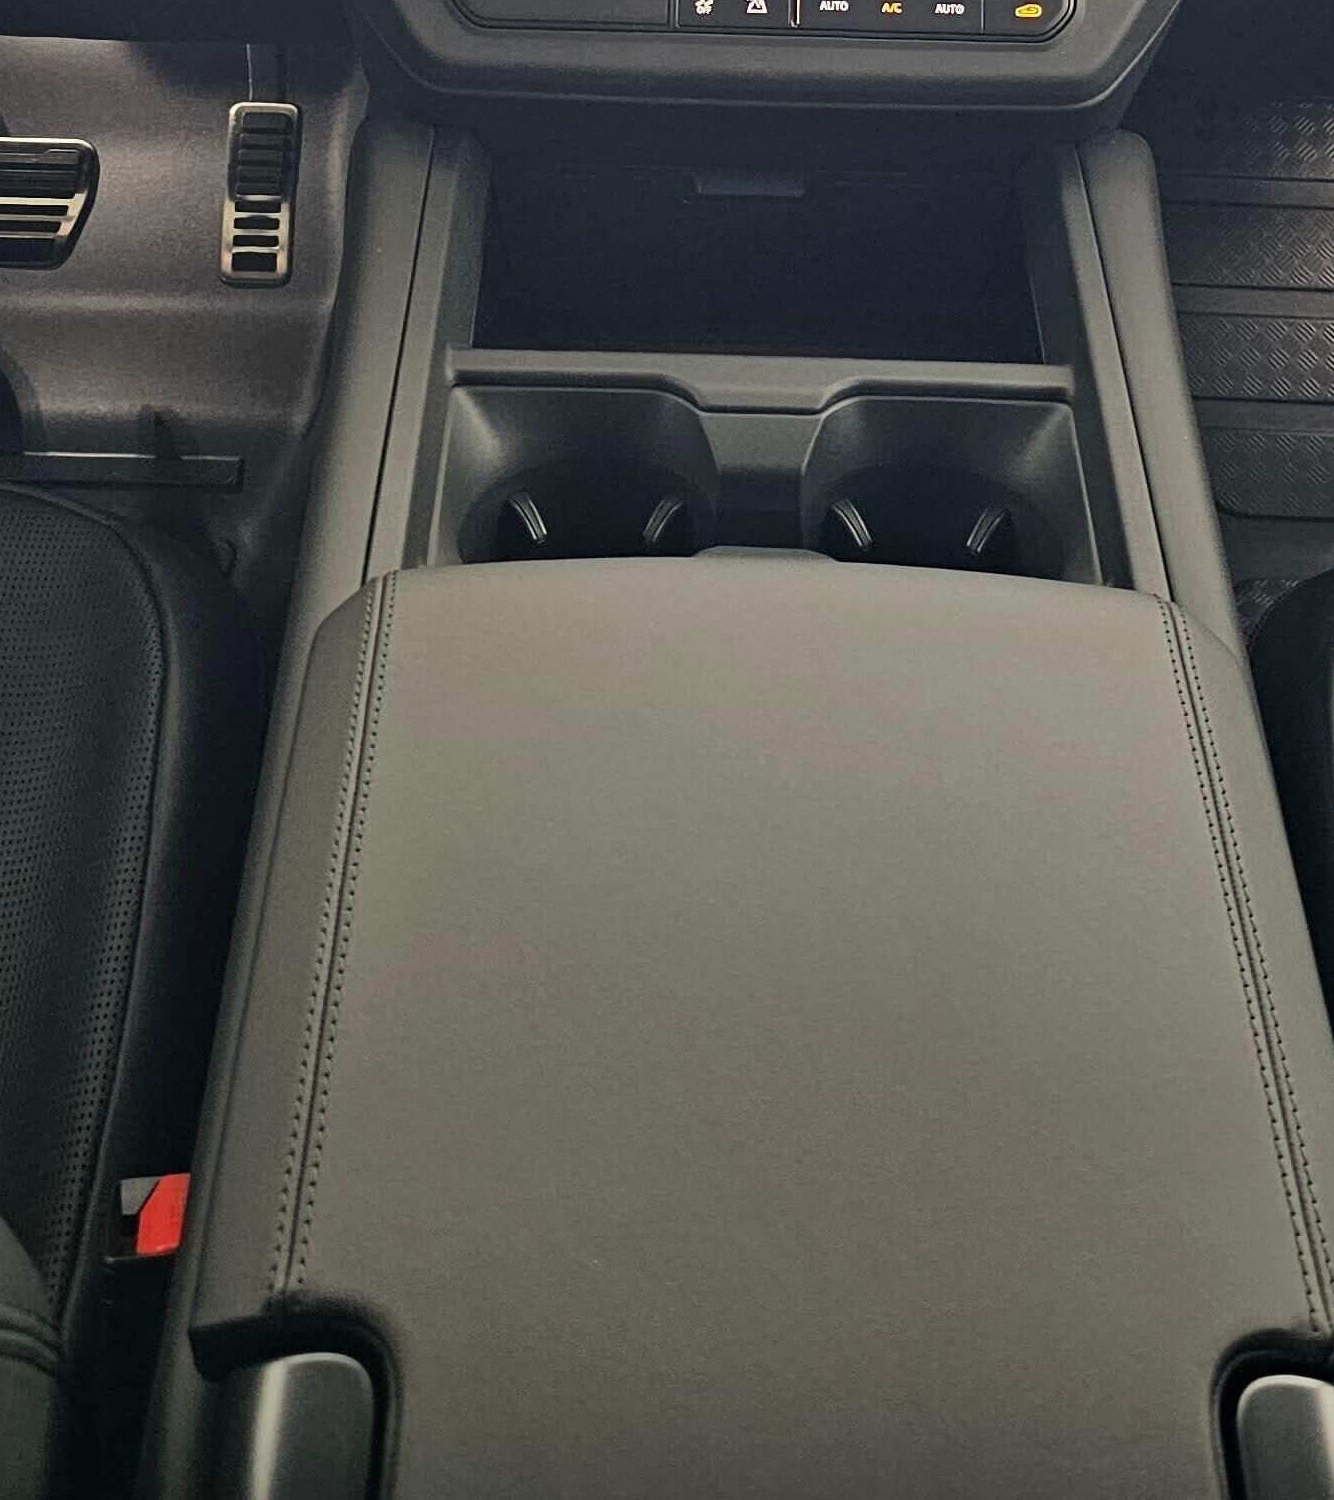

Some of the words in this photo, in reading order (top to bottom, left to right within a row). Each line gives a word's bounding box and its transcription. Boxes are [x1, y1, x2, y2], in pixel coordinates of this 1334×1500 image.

[819, 0, 849, 12] AUTO
[881, 2, 903, 14] A/C
[934, 3, 965, 15] AUTO
